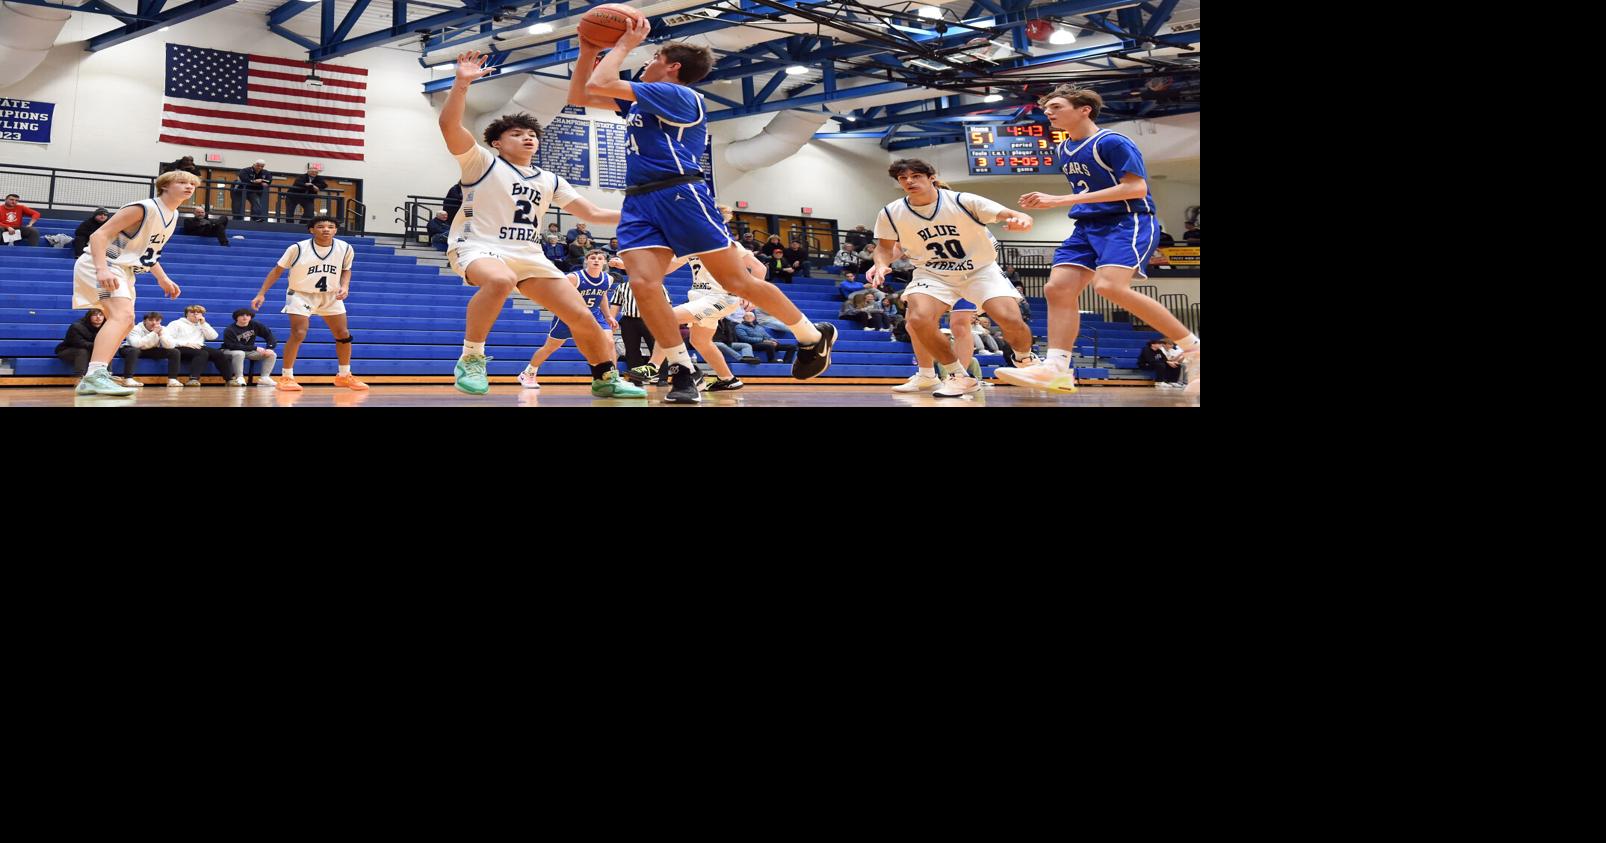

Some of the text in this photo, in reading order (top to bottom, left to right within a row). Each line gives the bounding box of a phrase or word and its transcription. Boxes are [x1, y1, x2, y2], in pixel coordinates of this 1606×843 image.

[1007, 126, 1043, 136] 4:43
[972, 132, 994, 144] 51
[1039, 139, 1048, 149] 3
[978, 157, 988, 166] 3
[996, 157, 1004, 166] 5
[1044, 157, 1052, 166] 2
[513, 200, 539, 228] 2
[499, 227, 541, 244] STREA
[917, 225, 961, 241] BLUE
[926, 239, 966, 259] 30
[307, 264, 337, 275] BLUE
[315, 276, 327, 292] 4
[587, 298, 596, 308] 5
